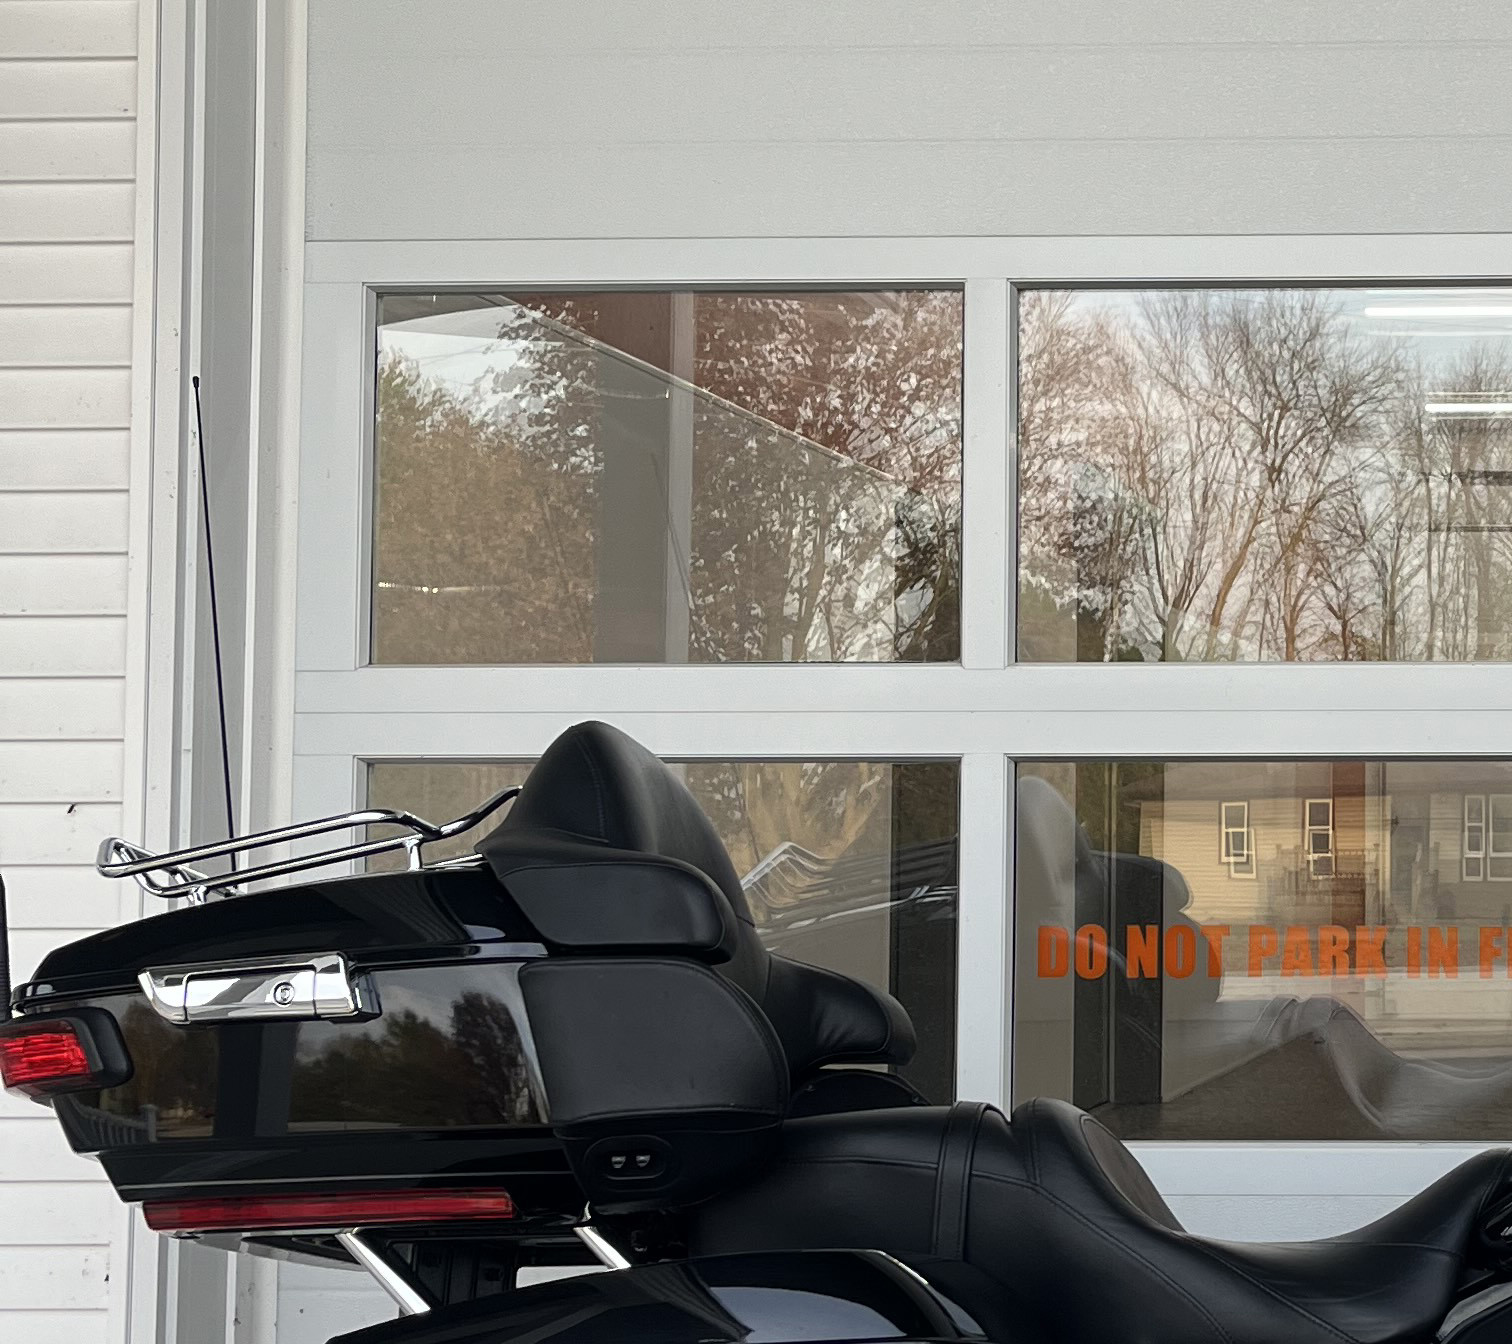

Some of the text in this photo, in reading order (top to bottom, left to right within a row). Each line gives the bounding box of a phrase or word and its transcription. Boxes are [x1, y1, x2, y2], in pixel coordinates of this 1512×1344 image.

[1038, 924, 1107, 980] DO
[1126, 924, 1230, 979] NOT
[1248, 924, 1387, 978] PARK
[1407, 926, 1459, 979] IN
